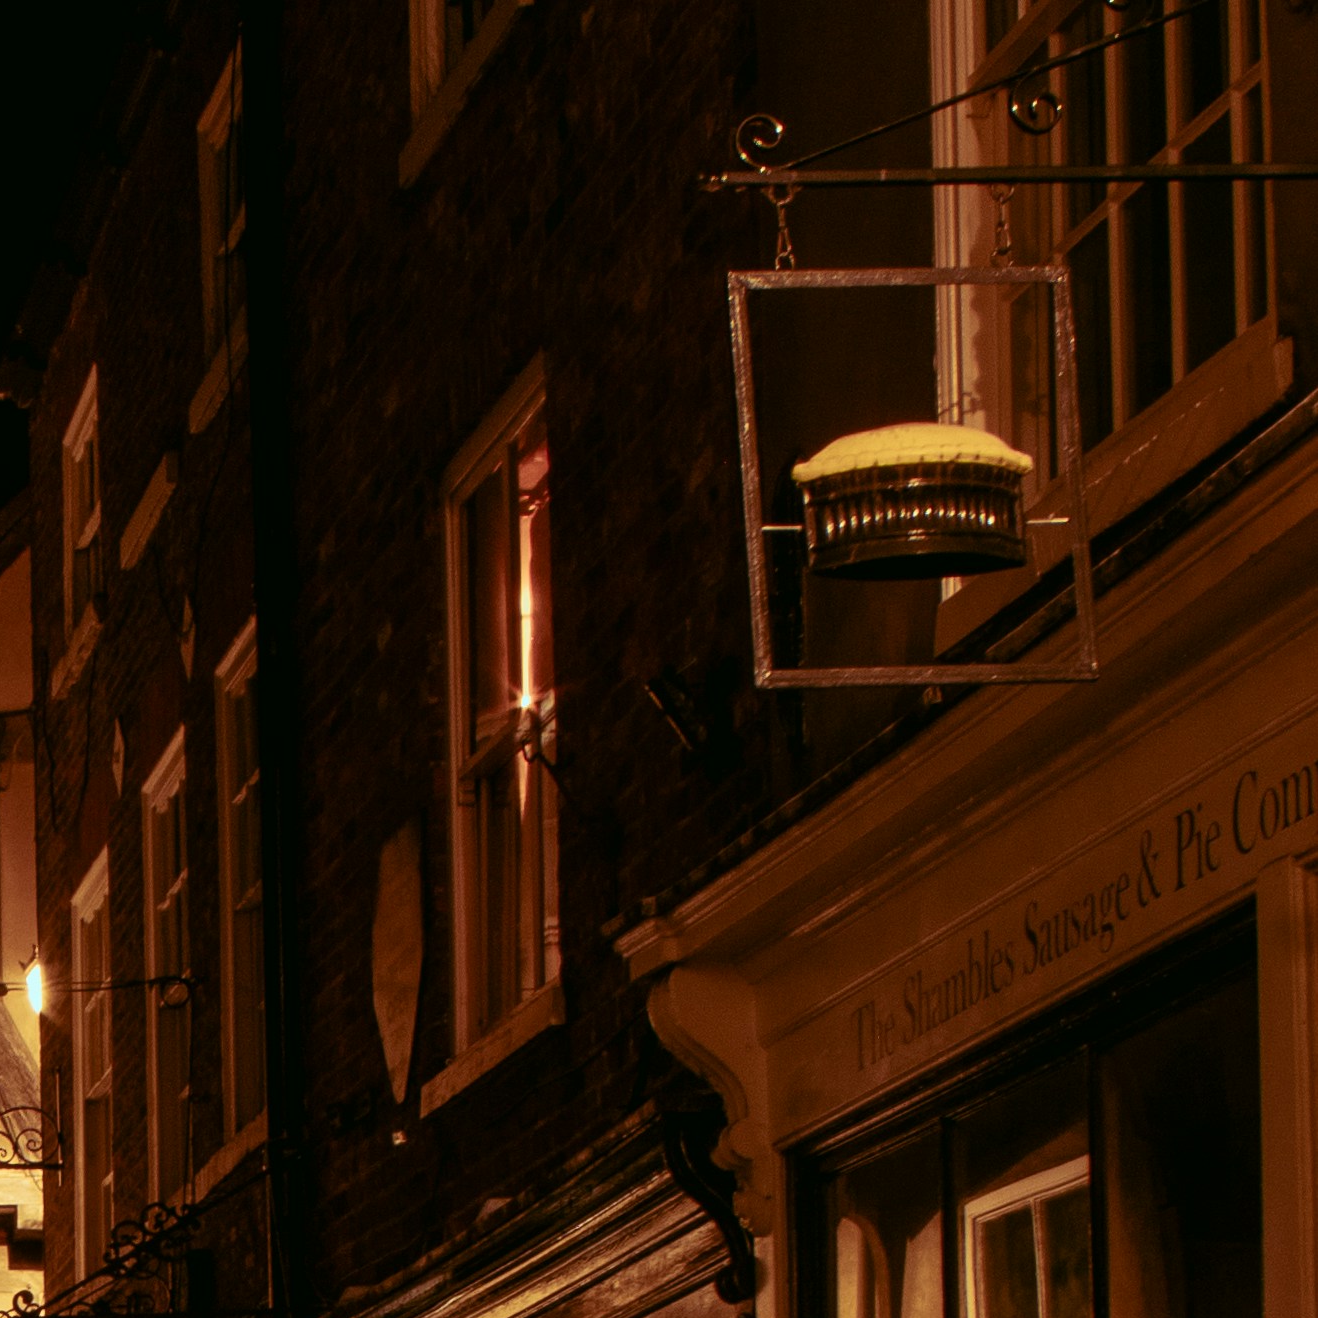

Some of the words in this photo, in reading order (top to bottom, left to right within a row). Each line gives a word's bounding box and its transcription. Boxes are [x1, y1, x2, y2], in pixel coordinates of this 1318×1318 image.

[853, 1003, 896, 1071] The
[902, 930, 1015, 1043] Shambles
[1021, 872, 1130, 975] Sausage
[1137, 829, 1161, 908] &
[1174, 801, 1222, 893] Pie
[1232, 759, 1318, 856] Com
